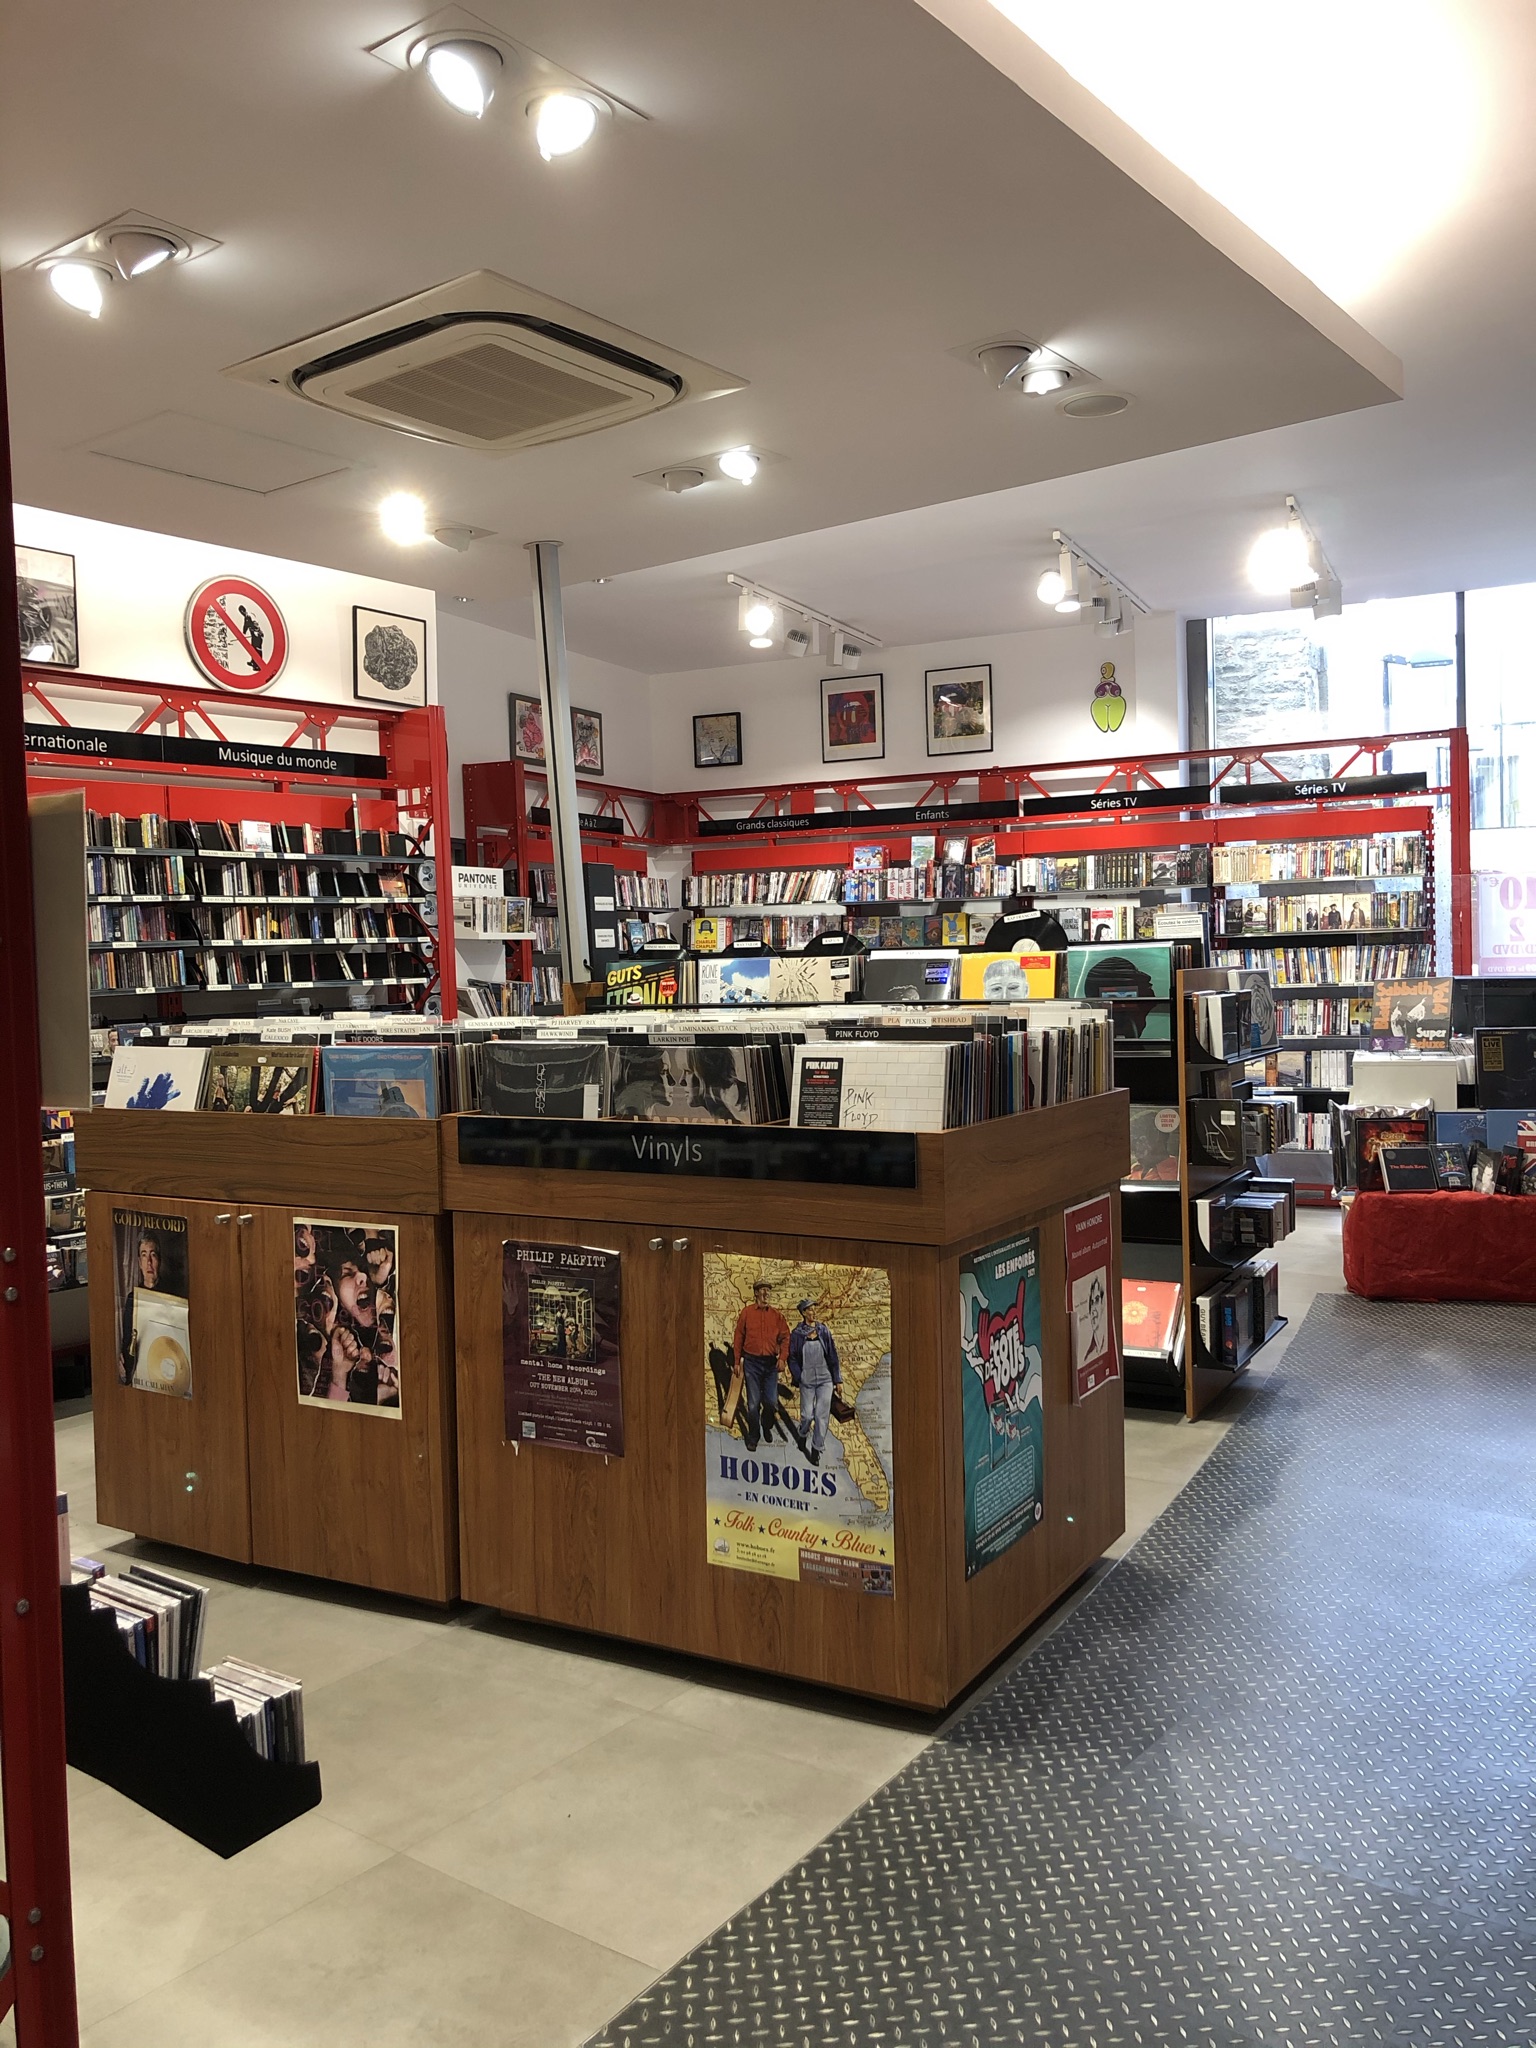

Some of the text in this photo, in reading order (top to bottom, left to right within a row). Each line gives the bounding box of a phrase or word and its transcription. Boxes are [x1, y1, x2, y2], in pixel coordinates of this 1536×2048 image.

[218, 747, 337, 770] Musique du monde
[1295, 782, 1347, 796] Séries TV
[1090, 797, 1138, 810] Séries TV
[736, 817, 810, 831] Grands classiques
[915, 810, 950, 821] Enfants
[458, 873, 497, 884] PANTONE
[607, 964, 643, 986] GUTS
[1376, 981, 1433, 997] Sabbath
[1373, 996, 1391, 1030] Black
[835, 1030, 879, 1038] PINK FLOYD
[1416, 1027, 1447, 1040] Super
[844, 1087, 875, 1110] PINK
[843, 1104, 879, 1130] FLOYD
[631, 1134, 703, 1167] Vinyls
[114, 1212, 186, 1233] GOLD RECORD
[516, 1249, 607, 1268] PHILIP PARFITT
[995, 1248, 1036, 1280] LES ENFOIRÉS
[520, 1359, 606, 1376] mental home recordings
[530, 1381, 540, 1389] OUT
[541, 1383, 569, 1393] NOVEMBER
[584, 1389, 598, 1397] 2020
[537, 1373, 551, 1382] THE
[552, 1375, 566, 1384] NEW
[567, 1377, 588, 1387] ALBUM
[720, 1455, 838, 1497] HOBOES
[745, 1492, 759, 1503] EN
[762, 1494, 811, 1512] CONCERT
[723, 1509, 876, 1555] Folk Country Blues
